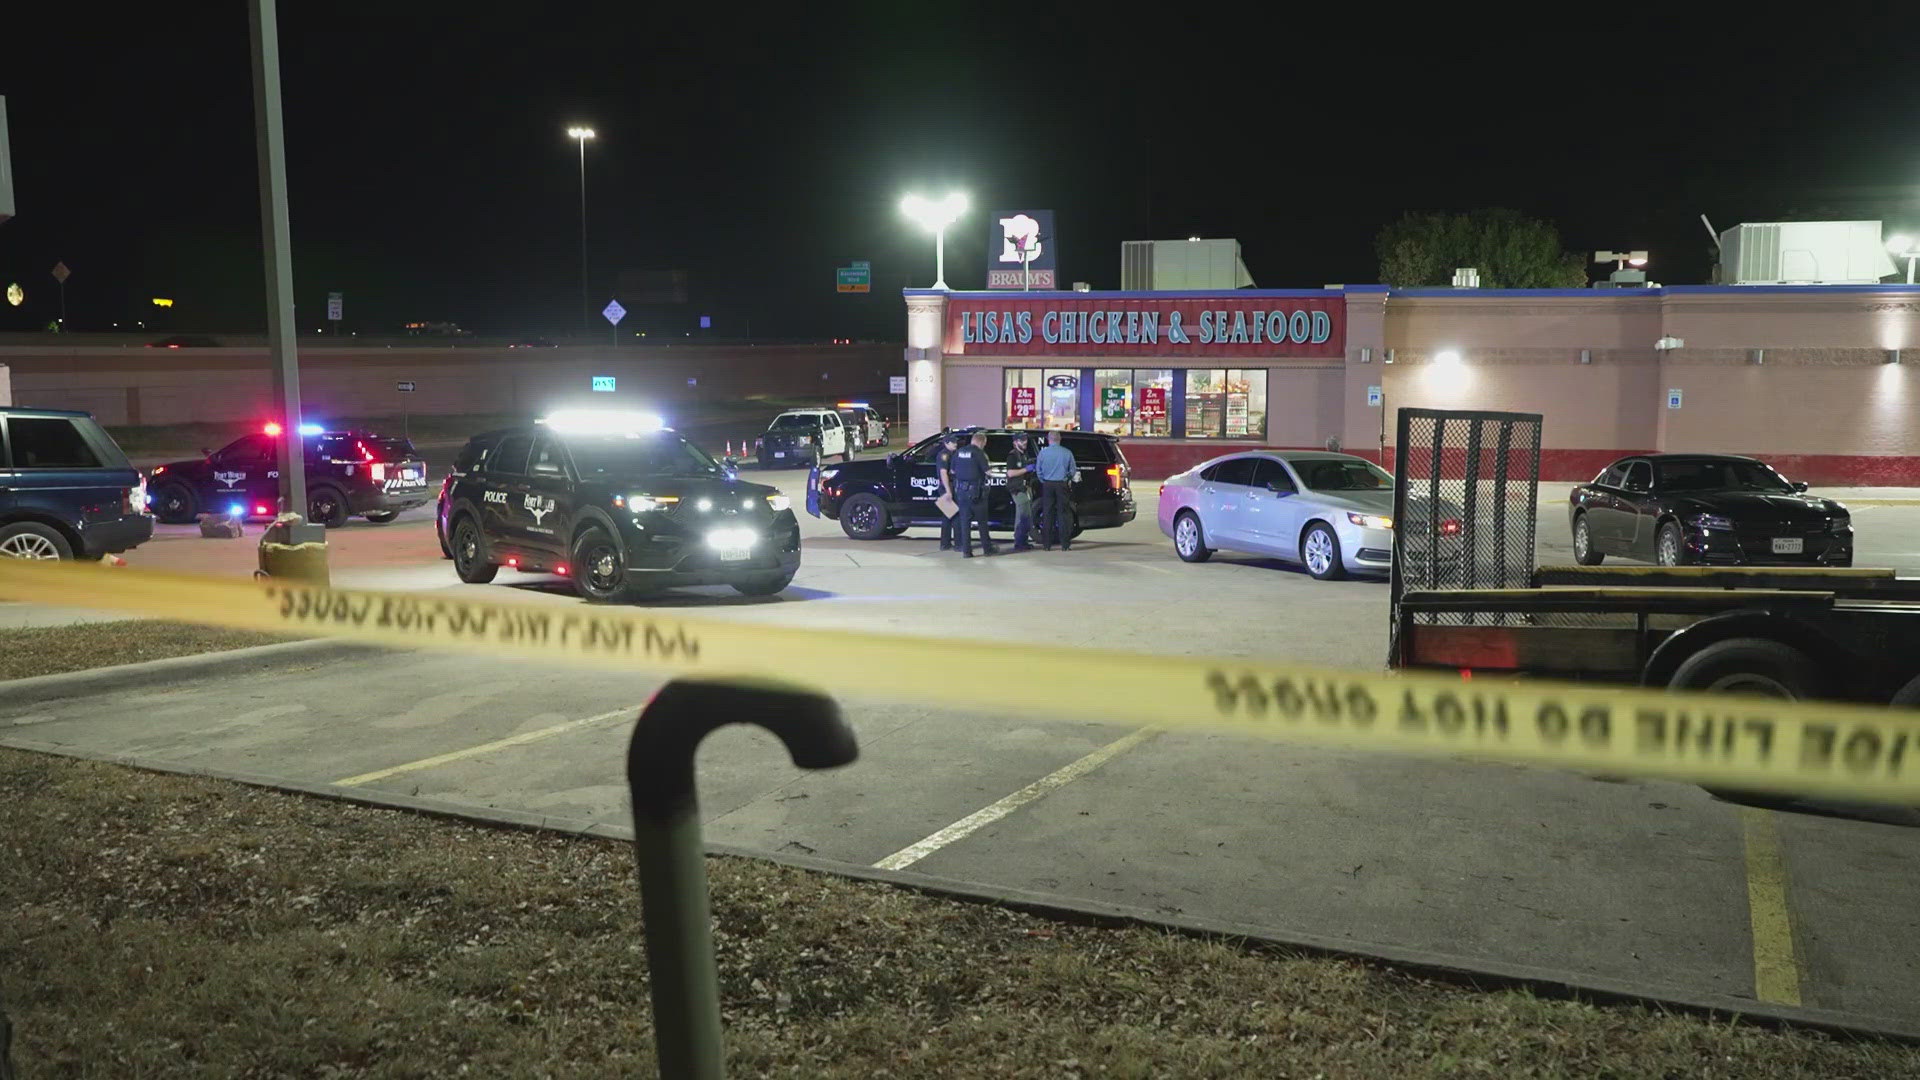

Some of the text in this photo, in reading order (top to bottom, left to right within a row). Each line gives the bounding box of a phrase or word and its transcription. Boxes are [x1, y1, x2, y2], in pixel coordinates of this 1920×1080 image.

[961, 310, 1332, 344] LISA'S CHICKEN & SEAFOOD
[1037, 436, 1045, 445] N
[483, 490, 508, 504] POLICE
[910, 477, 926, 486] FORT
[1399, 686, 1509, 739] NOT
[1536, 696, 1612, 747] DO
[1636, 709, 1776, 760] LINE
